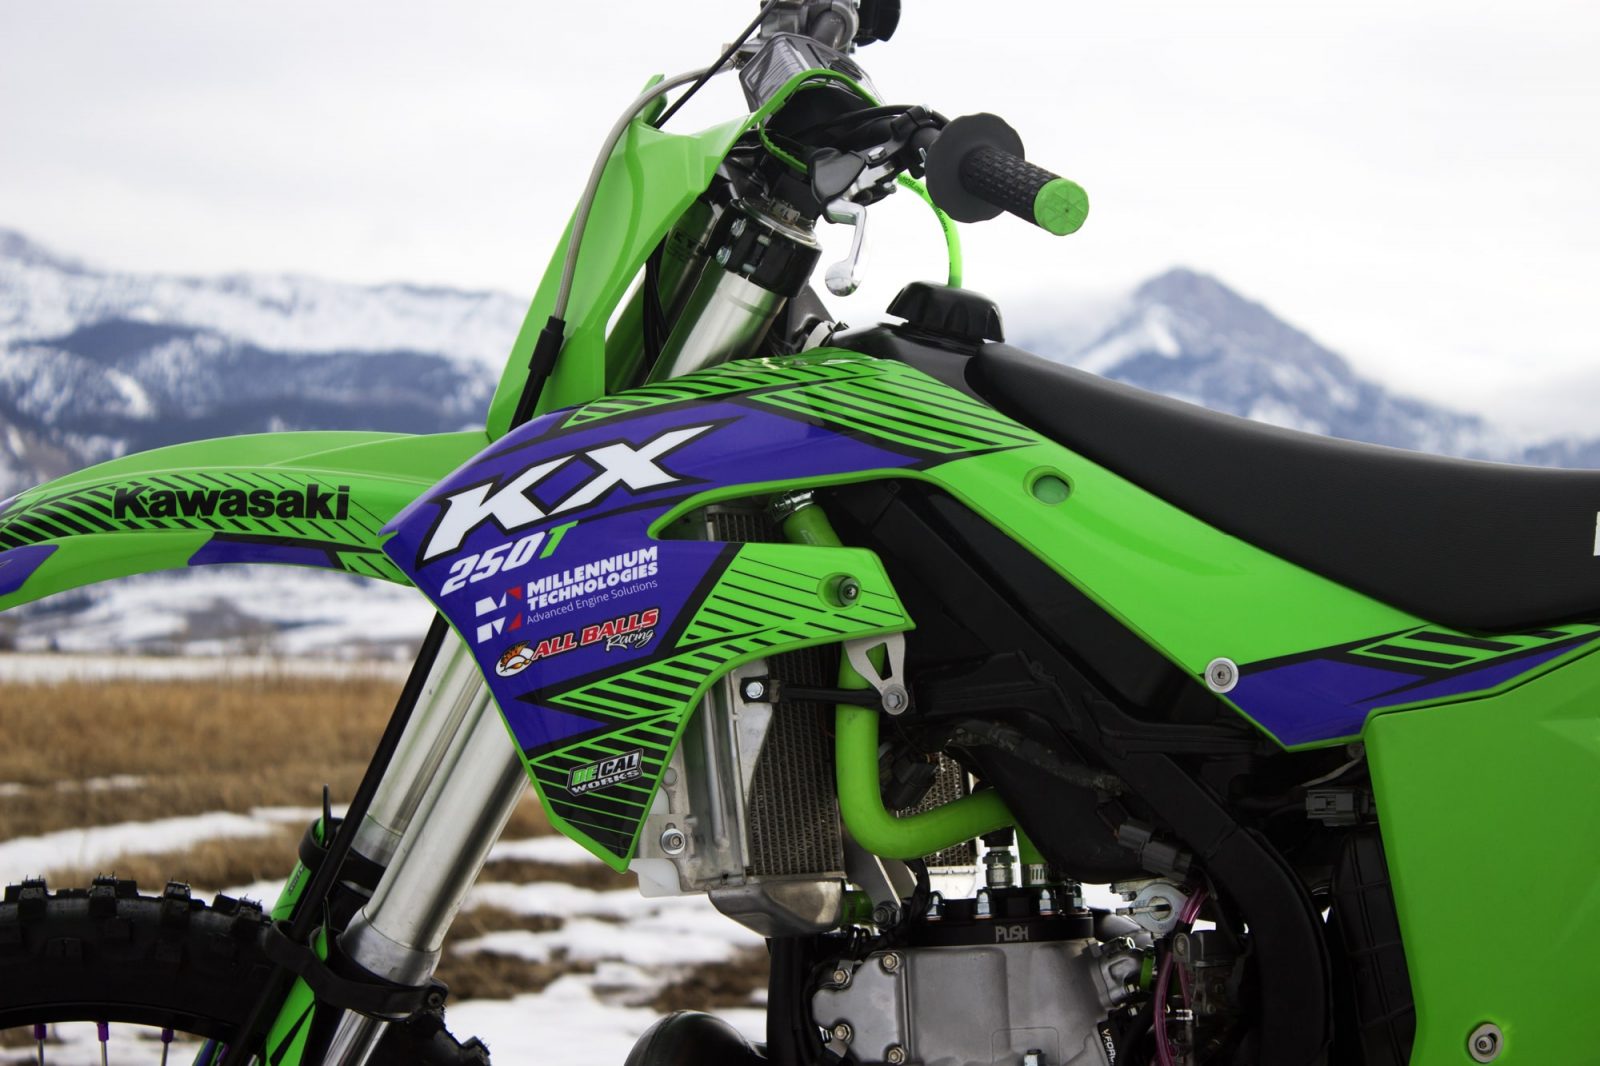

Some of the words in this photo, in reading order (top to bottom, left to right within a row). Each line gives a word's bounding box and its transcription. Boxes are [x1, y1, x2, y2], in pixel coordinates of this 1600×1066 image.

[113, 484, 350, 521] Kawasaki
[422, 424, 715, 561] KX
[440, 520, 579, 597] 250T
[527, 546, 658, 598] MILLENNIUM
[526, 601, 574, 625] Advanced
[575, 593, 609, 609] Engine
[611, 579, 658, 597] Solutions
[527, 562, 658, 612] TECHNOLOGIES
[532, 632, 577, 660] ALL
[580, 608, 659, 646] BALLS
[605, 627, 654, 652] Racing
[571, 769, 640, 793] WORKS
[995, 925, 1029, 943] PUSH
